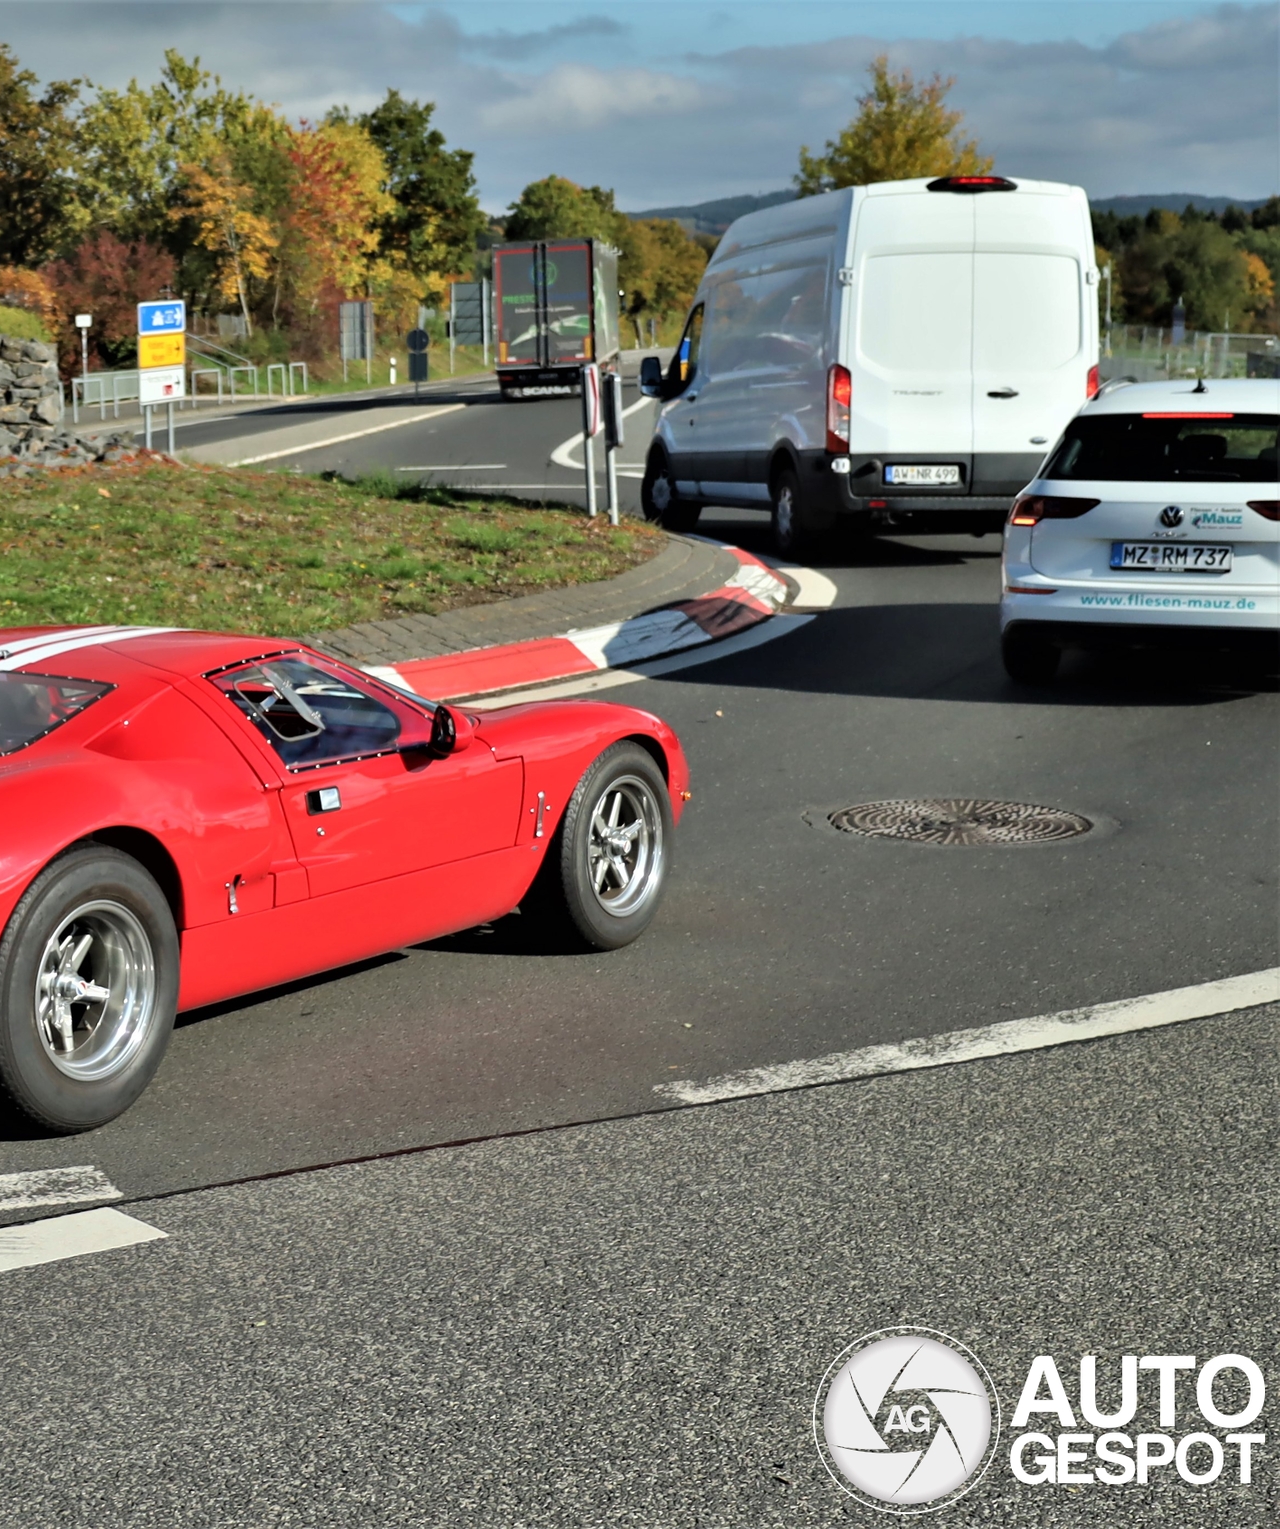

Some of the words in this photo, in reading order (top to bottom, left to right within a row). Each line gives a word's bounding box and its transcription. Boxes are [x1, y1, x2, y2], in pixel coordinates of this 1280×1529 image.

[522, 386, 572, 396] SCANIA
[893, 468, 909, 480] AW
[917, 468, 932, 480] NR
[935, 468, 957, 480] 499
[1201, 513, 1243, 525] Mauz
[1123, 546, 1150, 565] MZ
[1162, 546, 1188, 565] RM
[1193, 547, 1230, 566] 737
[1080, 593, 1256, 610] www.fliesen-mauz.de
